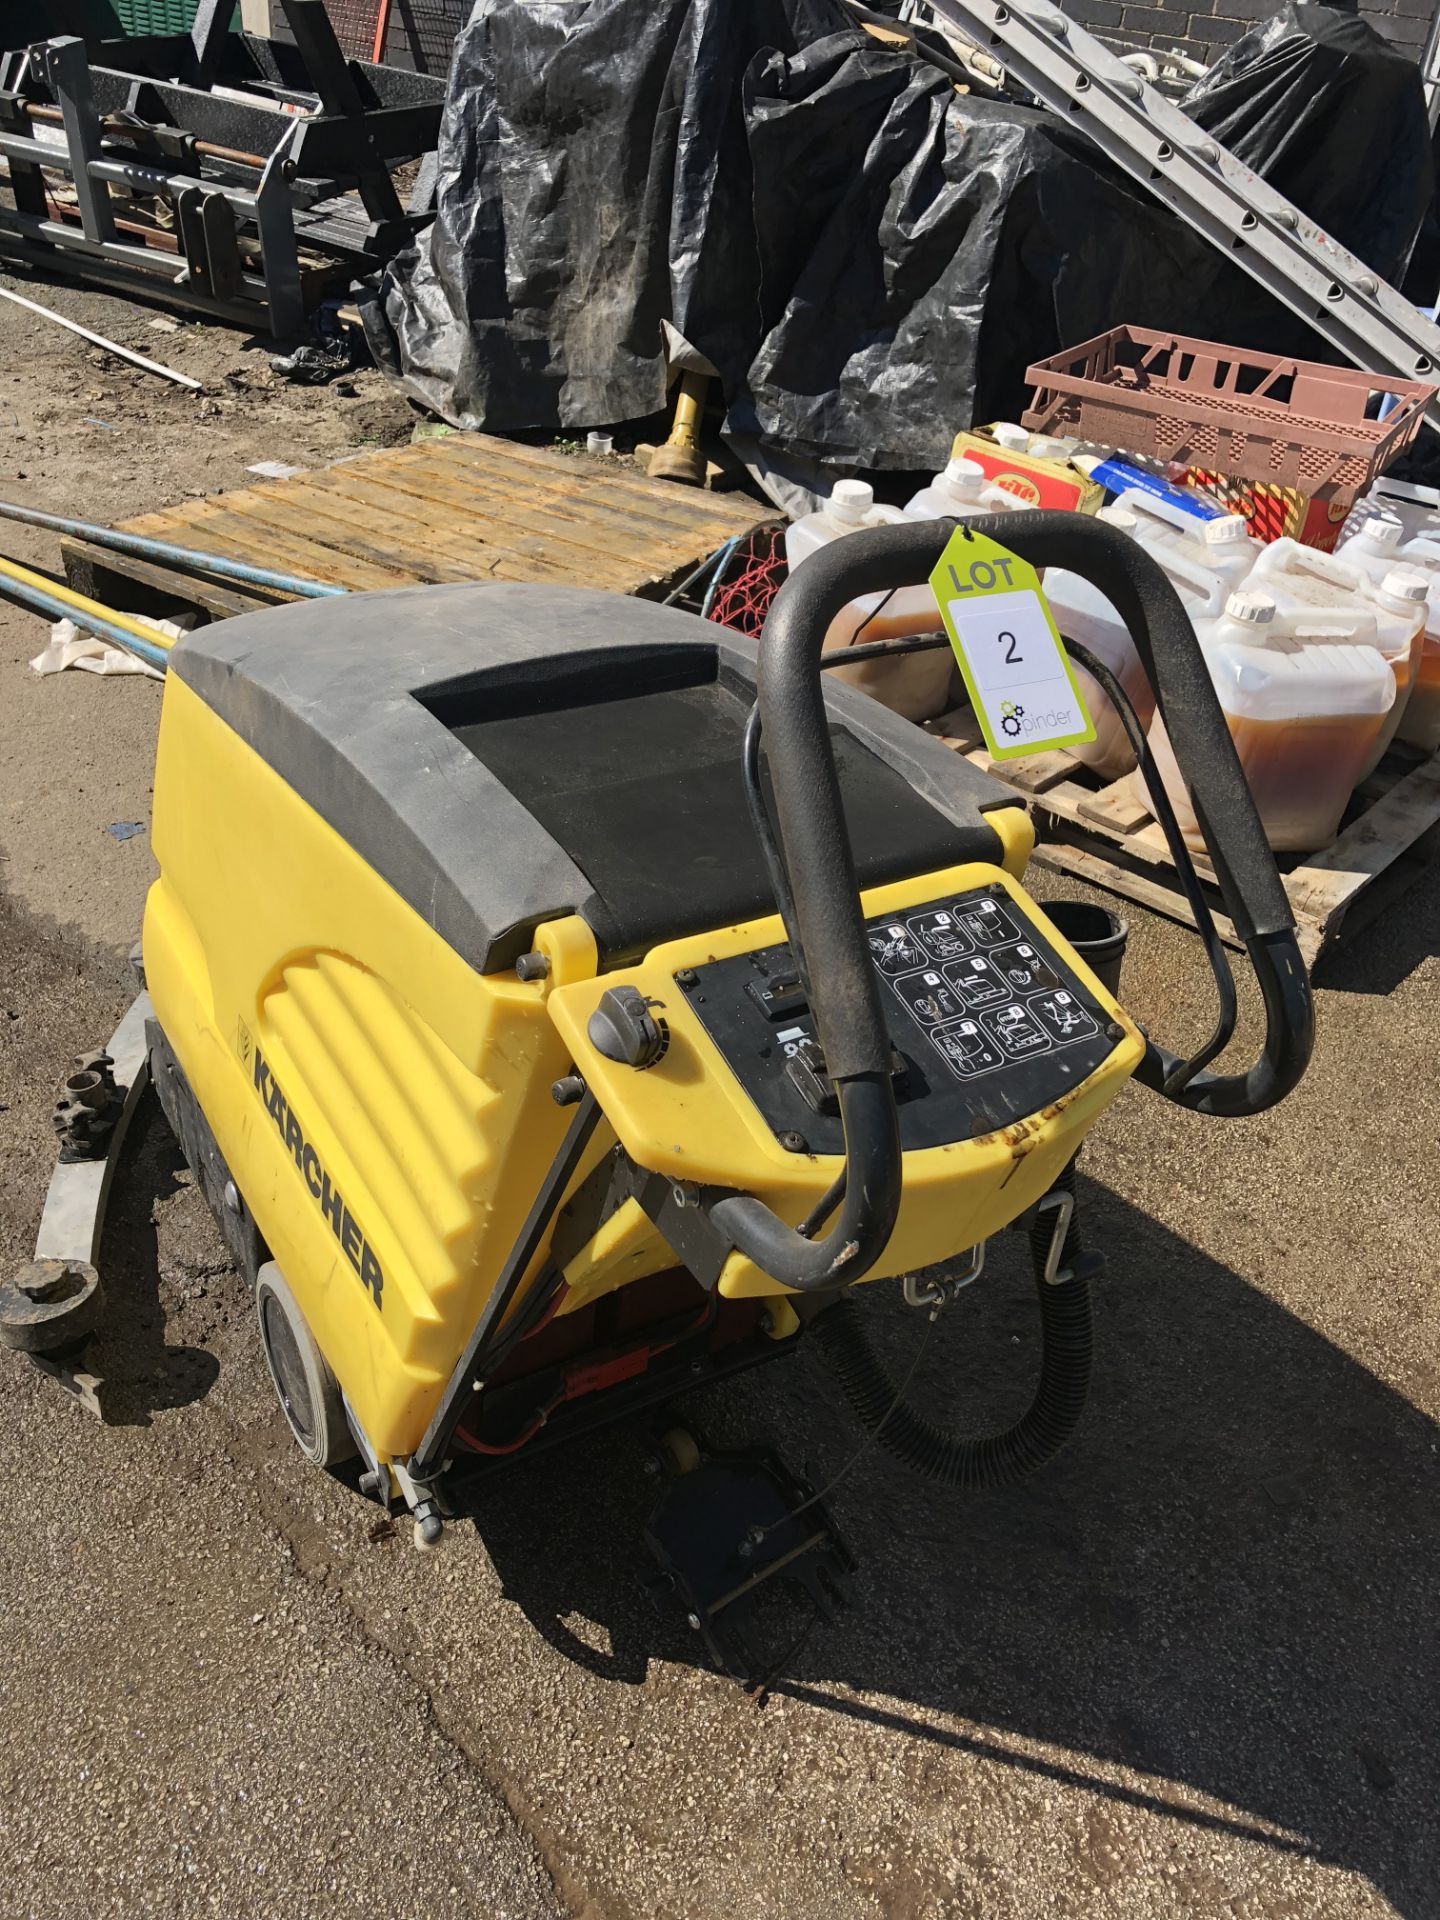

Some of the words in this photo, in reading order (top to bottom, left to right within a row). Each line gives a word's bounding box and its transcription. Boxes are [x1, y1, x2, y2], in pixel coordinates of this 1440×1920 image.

[948, 557, 1013, 593] LOT
[997, 631, 1024, 664] 2
[1022, 708, 1072, 738] pinder
[254, 1046, 383, 1312] KÄRCHER
